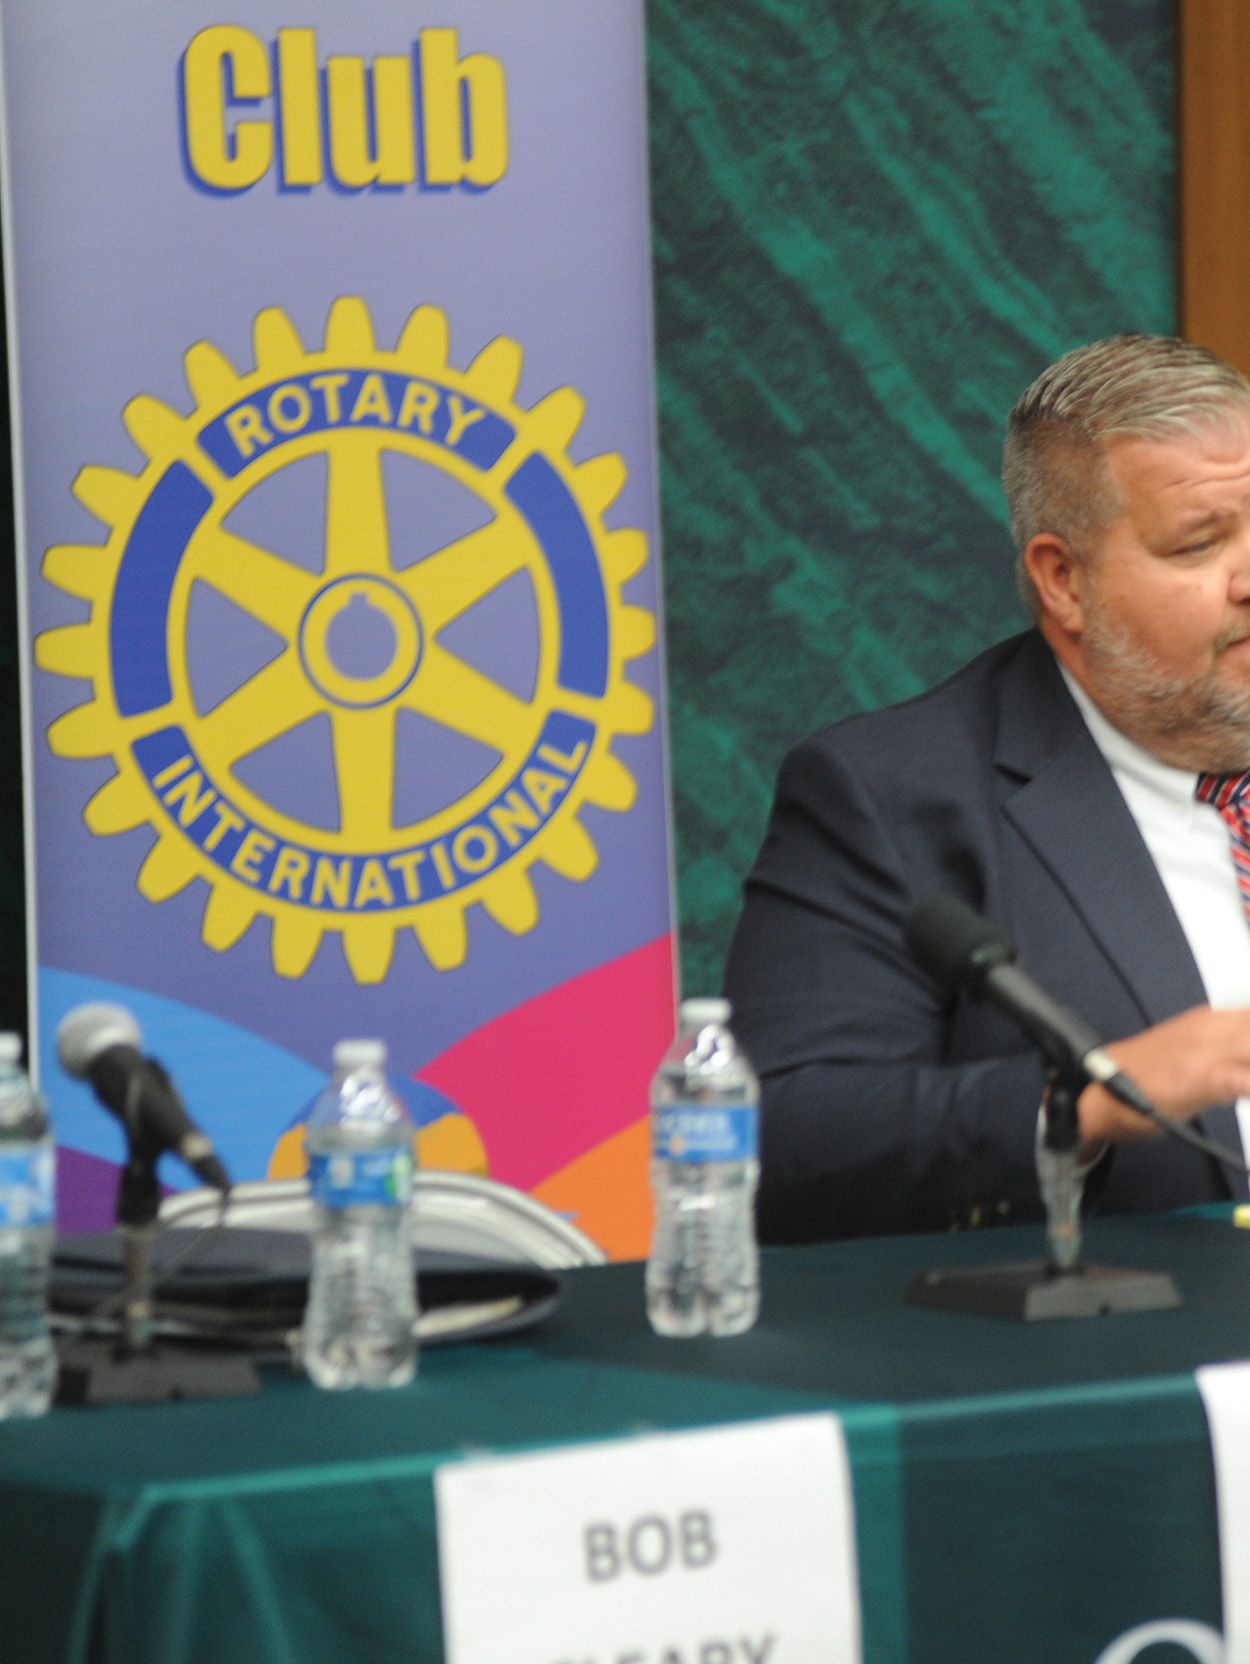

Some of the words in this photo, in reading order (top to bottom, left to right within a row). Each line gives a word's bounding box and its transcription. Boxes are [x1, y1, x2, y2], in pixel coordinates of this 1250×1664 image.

[178, 24, 508, 197] Club
[224, 373, 486, 460] ROTARY
[153, 739, 590, 910] INTERNATIONAL
[582, 1509, 720, 1585] BOB
